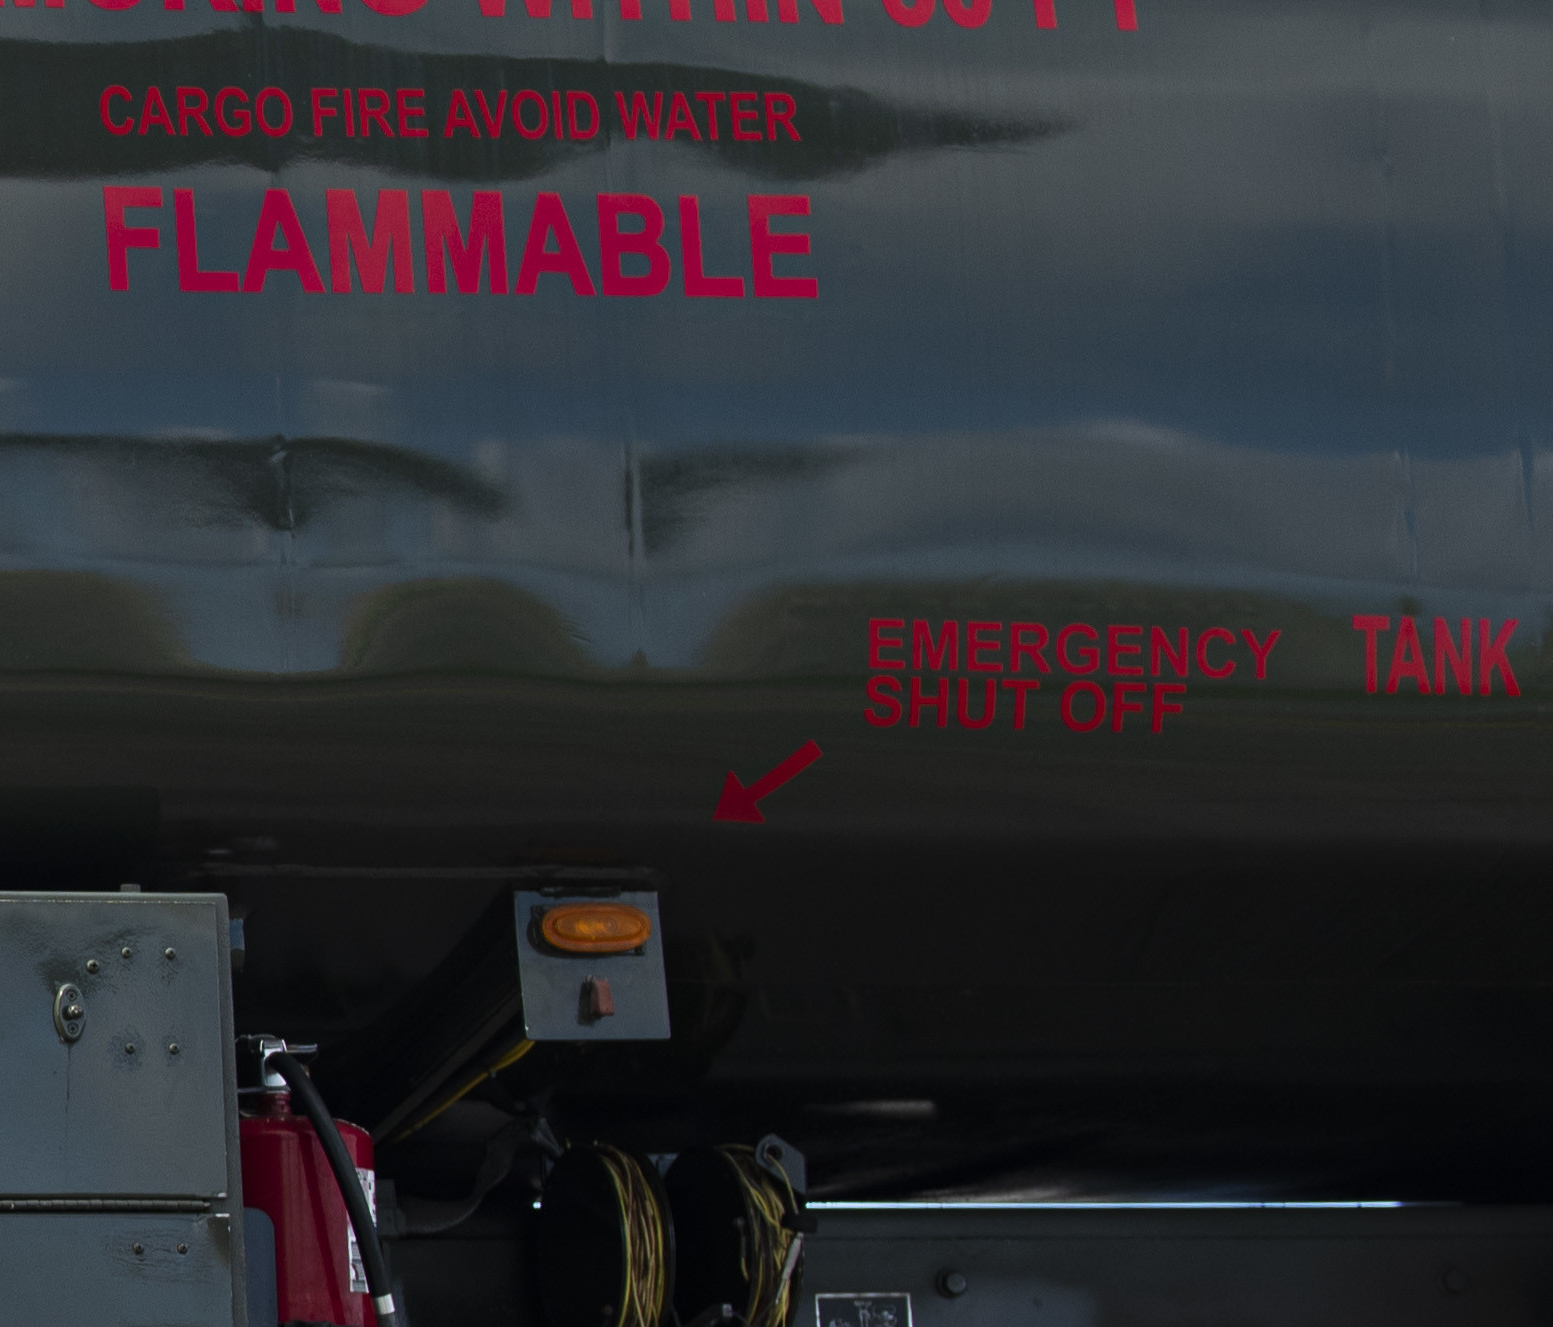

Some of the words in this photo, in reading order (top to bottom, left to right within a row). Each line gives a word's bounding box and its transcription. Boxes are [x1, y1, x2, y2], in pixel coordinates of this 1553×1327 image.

[99, 84, 295, 140] CARGO
[311, 86, 429, 140] FIRE
[441, 88, 601, 142] AVOID
[615, 90, 802, 144] WATER
[104, 186, 818, 298] FLAMMABLE
[868, 618, 1282, 679] EMERGENCY
[1353, 614, 1522, 697] TANK
[865, 676, 1038, 731] SHUT
[1059, 680, 1188, 733] OFF
